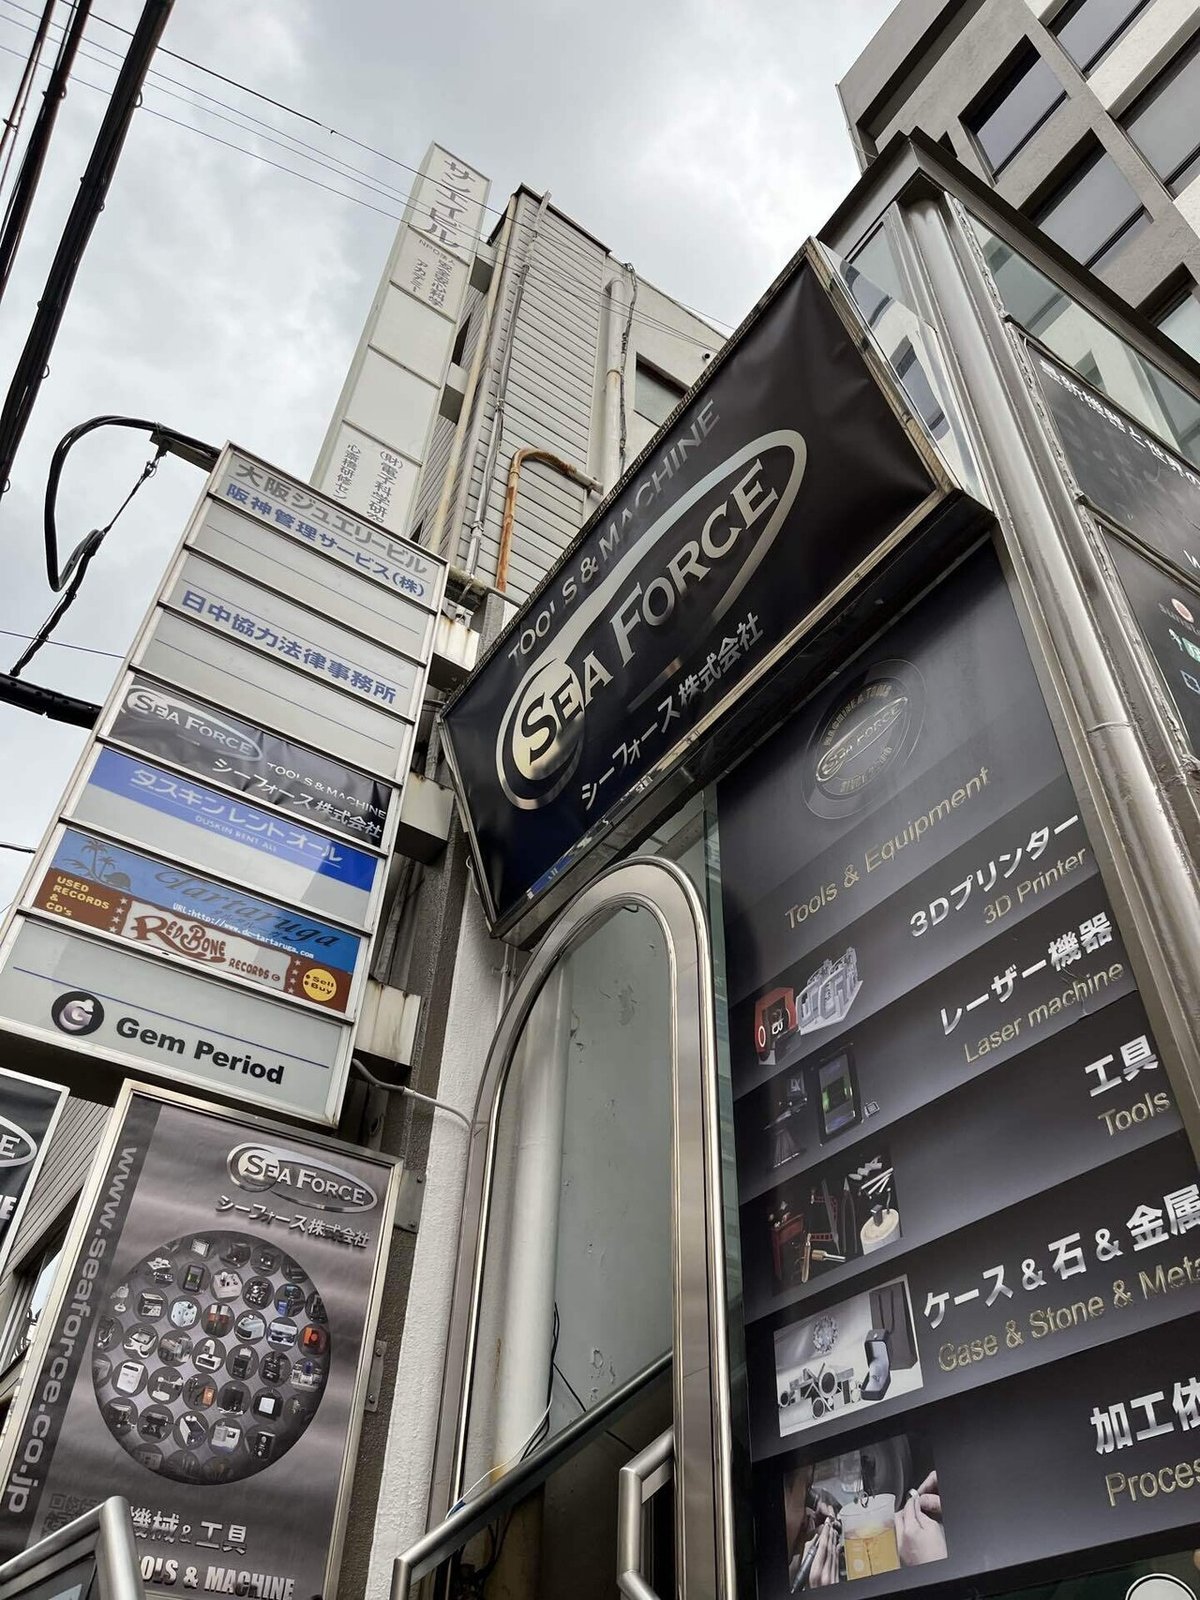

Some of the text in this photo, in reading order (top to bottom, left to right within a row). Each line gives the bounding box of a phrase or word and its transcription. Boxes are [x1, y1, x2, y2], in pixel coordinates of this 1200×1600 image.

[424, 160, 476, 248] サンエイビル
[235, 463, 427, 574] 大阪ジュエリービル
[579, 556, 599, 580] &
[598, 399, 720, 561] MACHINE
[226, 483, 425, 597] 阪神管理サービス(株)
[520, 650, 613, 766] SEA
[609, 458, 778, 668] FORCE
[181, 590, 396, 704] 日中協力法律事務所
[132, 693, 253, 754] SEA FORCE
[582, 612, 764, 811] シーフォース株式会社
[195, 816, 233, 837] DUSKIN
[235, 829, 260, 848] RENT
[212, 757, 382, 839] シーフォース株式会社
[314, 781, 325, 792] &
[325, 786, 386, 819] MACHINE
[785, 883, 837, 928] Tools
[843, 865, 859, 887] &
[865, 766, 989, 873] Equipment
[910, 814, 1079, 937] 3Dプリンター
[46, 902, 72, 916] CD's
[49, 893, 59, 902] &
[53, 884, 110, 909] RECORDS
[57, 876, 89, 892] USED
[155, 870, 341, 947] Tartaruga
[983, 848, 1086, 925] 3D Printer
[229, 958, 270, 980] RECORDS
[311, 983, 333, 994] Buy
[313, 976, 334, 987] Sell
[941, 911, 1113, 1036] レーザー機器
[964, 962, 1125, 1063] Laser machine
[116, 1017, 284, 1085] Gem Period
[1084, 1035, 1159, 1097] 工具
[1097, 1092, 1170, 1136] Tools
[243, 1154, 367, 1206] SEA FORCE
[215, 1195, 371, 1248] シーフォース株式会社
[923, 1264, 1014, 1329] ケース
[1021, 1258, 1047, 1291] &
[1048, 1231, 1087, 1280] 石
[1095, 1228, 1124, 1261] &
[9, 1147, 137, 1514] www.seaforce.co.jp
[1006, 1319, 1024, 1348] &
[1029, 1296, 1105, 1339] Stone
[1113, 1279, 1133, 1309] &
[195, 1521, 247, 1555] 工具
[183, 1566, 199, 1588] &
[204, 1566, 296, 1600] MACHINE
